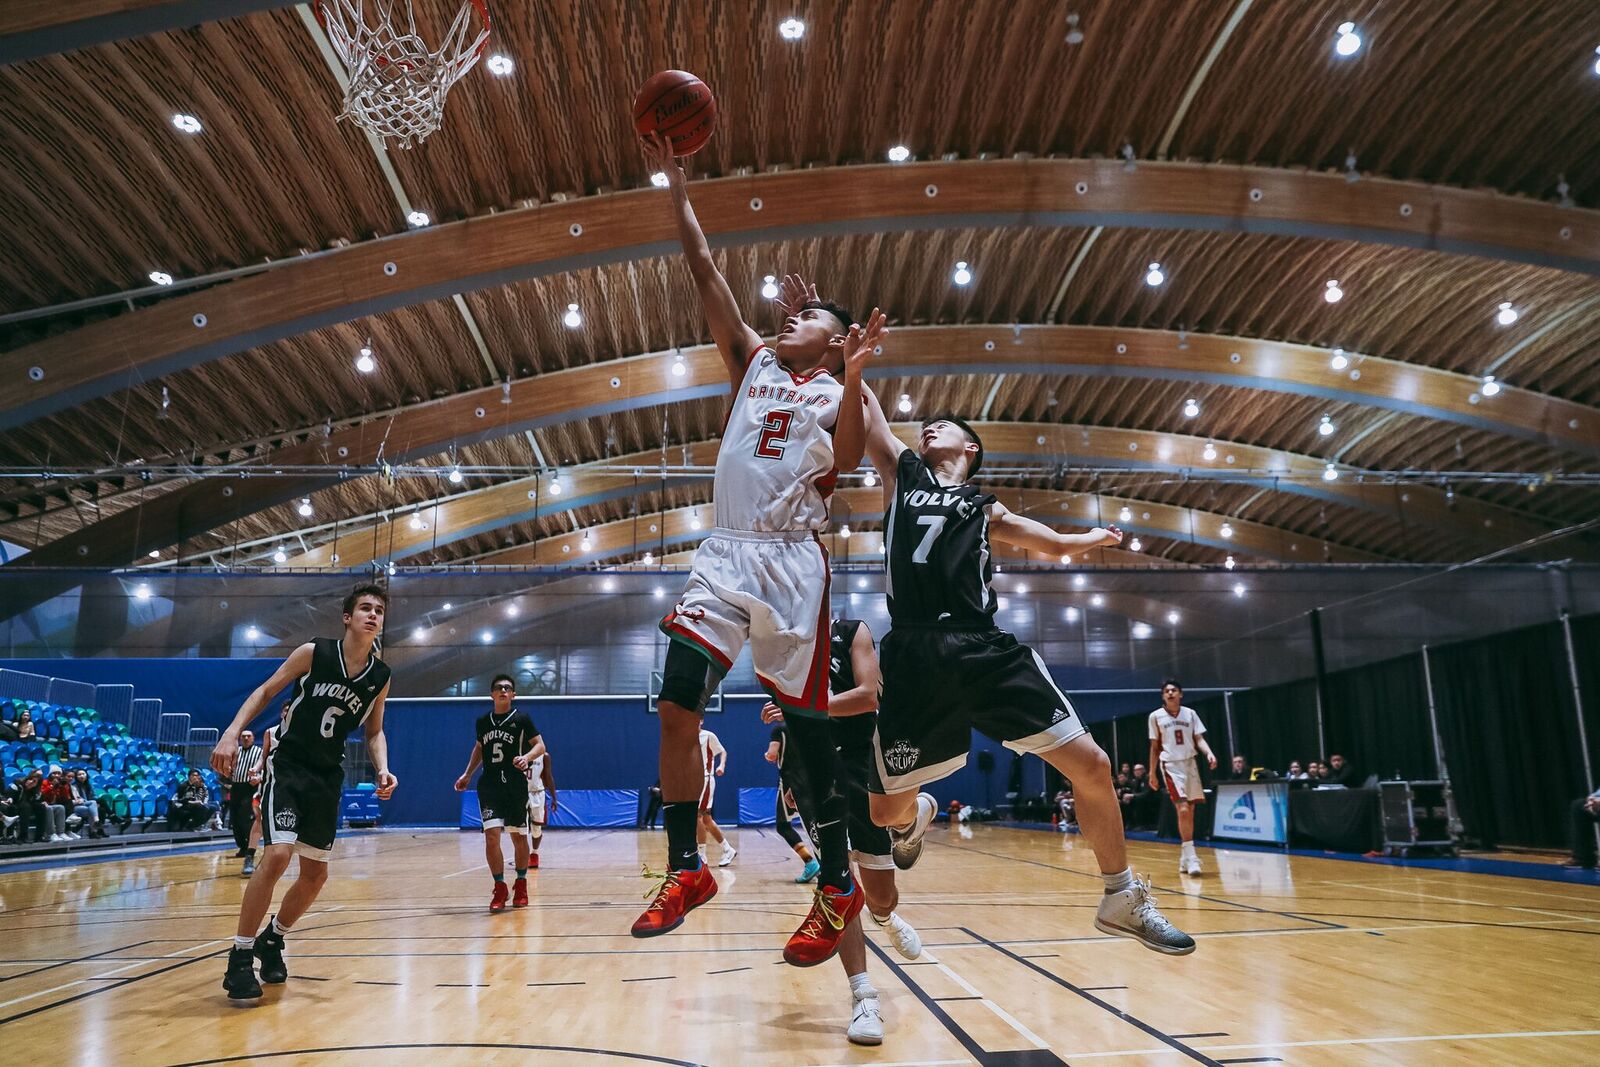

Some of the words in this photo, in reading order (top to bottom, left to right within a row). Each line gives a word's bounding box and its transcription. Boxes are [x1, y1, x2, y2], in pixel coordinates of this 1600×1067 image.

[754, 409, 794, 460] 2
[912, 515, 948, 563] 7
[312, 682, 363, 715] WOLVES
[320, 706, 345, 738] 6
[483, 729, 515, 745] WOLVES
[491, 742, 504, 763] 5
